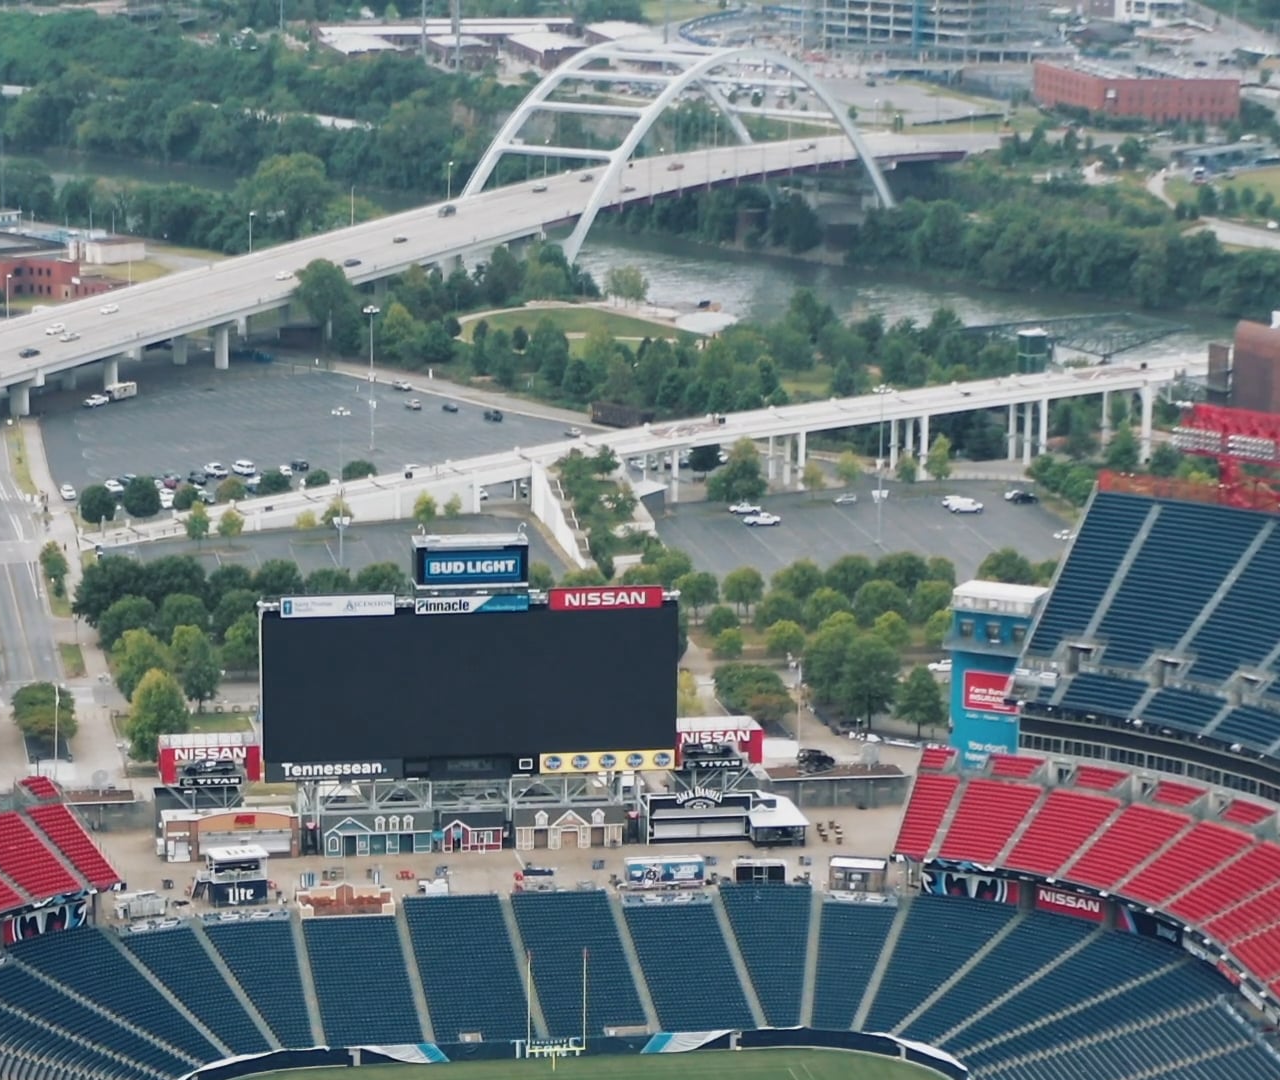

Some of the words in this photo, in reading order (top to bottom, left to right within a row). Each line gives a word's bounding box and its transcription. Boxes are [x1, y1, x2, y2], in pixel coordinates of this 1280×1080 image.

[429, 560, 466, 575] BUD
[467, 559, 516, 575] LIGHT
[564, 590, 646, 606] NISSAN
[417, 599, 469, 613] Pinnacle
[681, 730, 751, 744] NISSAN
[174, 747, 247, 761] NISSAN
[699, 759, 741, 769] TITAN
[197, 777, 239, 786] TITAN
[227, 887, 255, 907] Lite
[1039, 888, 1100, 913] NISSAN
